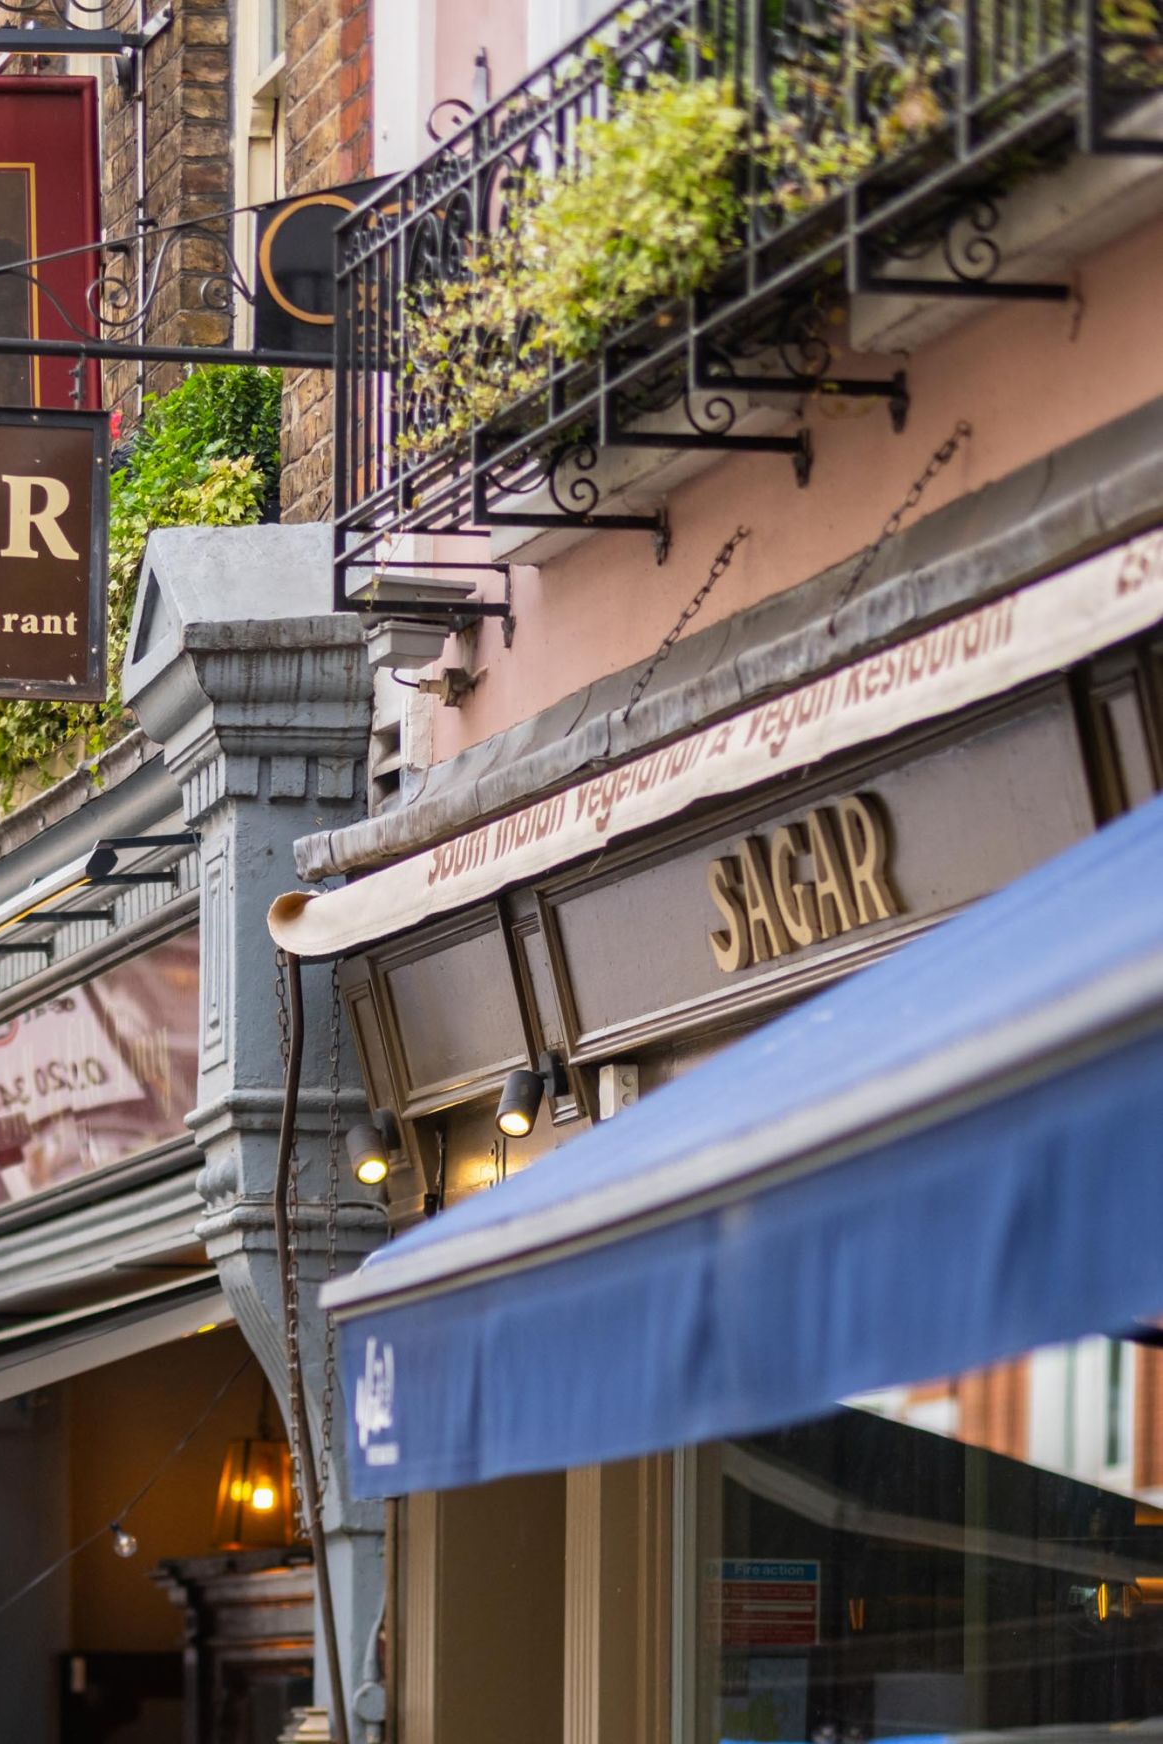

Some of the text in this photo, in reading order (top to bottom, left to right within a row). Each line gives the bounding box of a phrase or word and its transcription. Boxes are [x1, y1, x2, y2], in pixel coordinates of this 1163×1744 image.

[708, 792, 897, 974] SAGAR
[734, 1564, 805, 1577] Fire action
